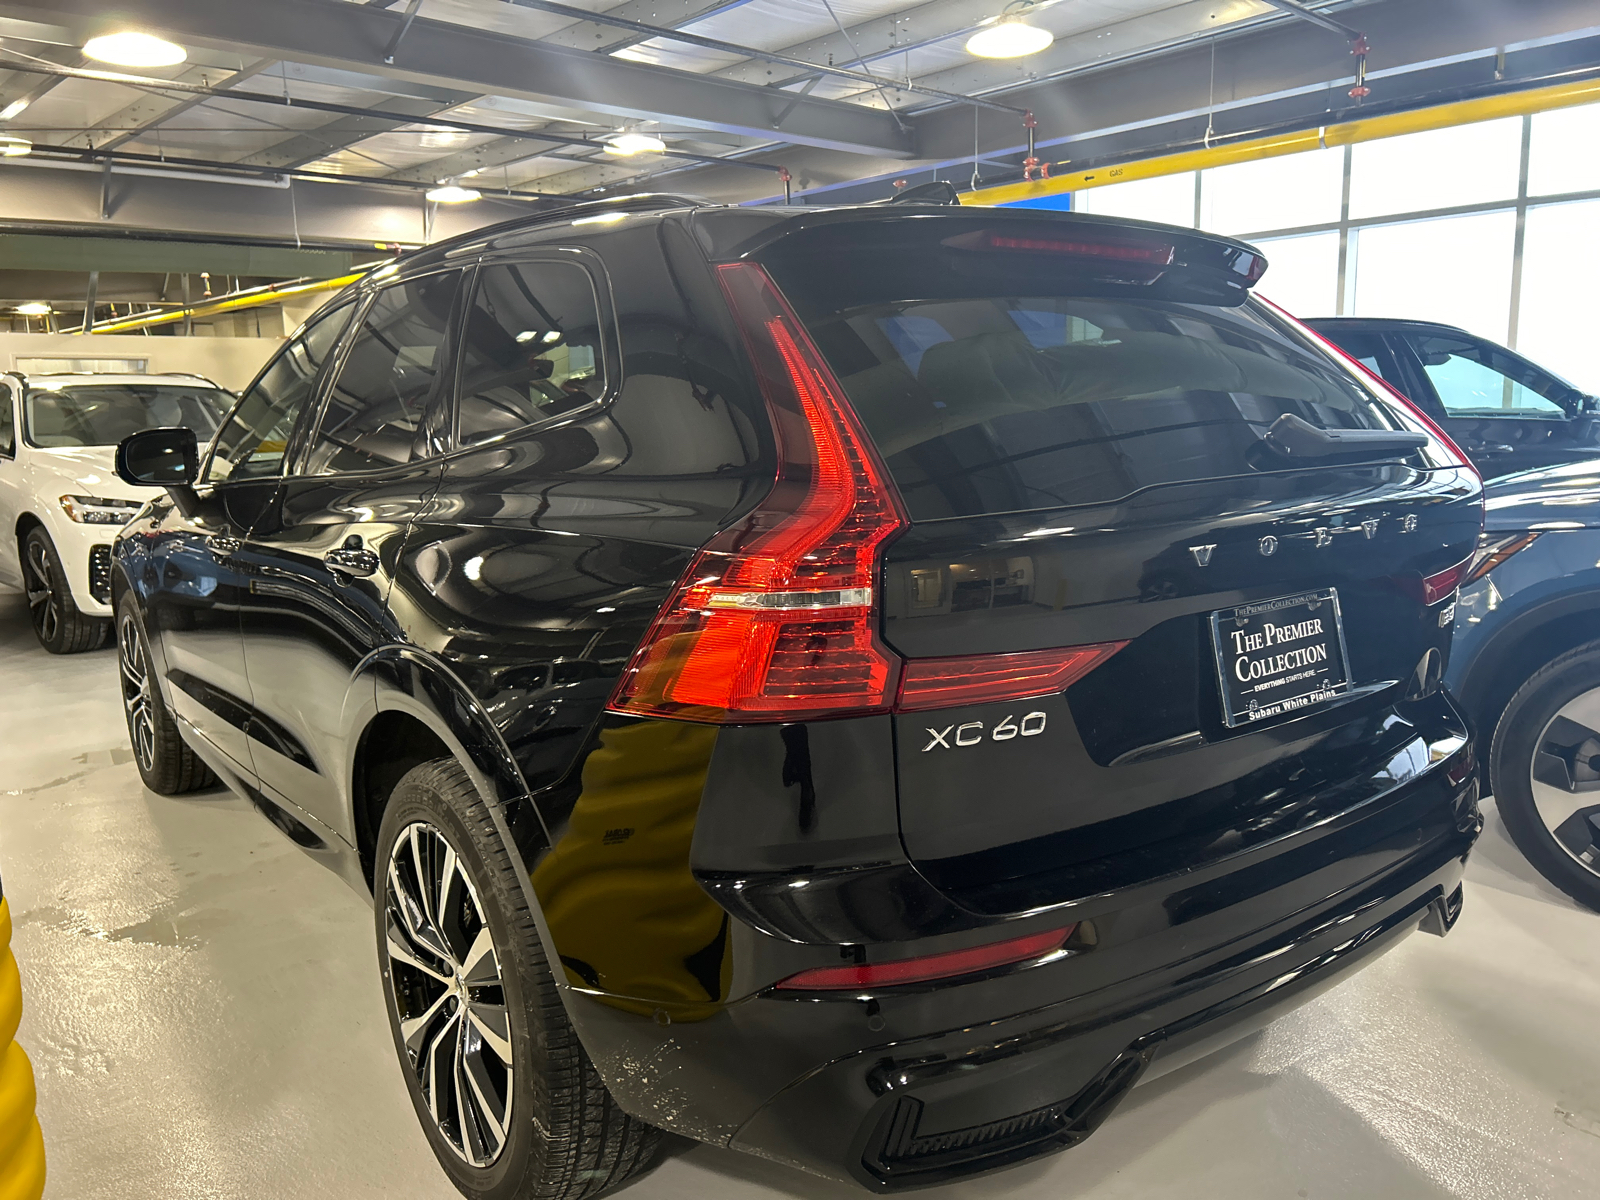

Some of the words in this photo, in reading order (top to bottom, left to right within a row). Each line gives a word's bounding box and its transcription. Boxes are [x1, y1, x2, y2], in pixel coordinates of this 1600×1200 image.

[1109, 168, 1123, 178] GAS
[1189, 513, 1417, 566] VOLVO
[1263, 618, 1324, 647] PREMIER
[1235, 643, 1327, 682] COLLECTION
[1254, 677, 1286, 692] EVERYTHING
[1285, 672, 1303, 684] STARTS
[1248, 705, 1281, 721] Subaru
[1282, 697, 1308, 711] White
[1310, 689, 1336, 703] Plains
